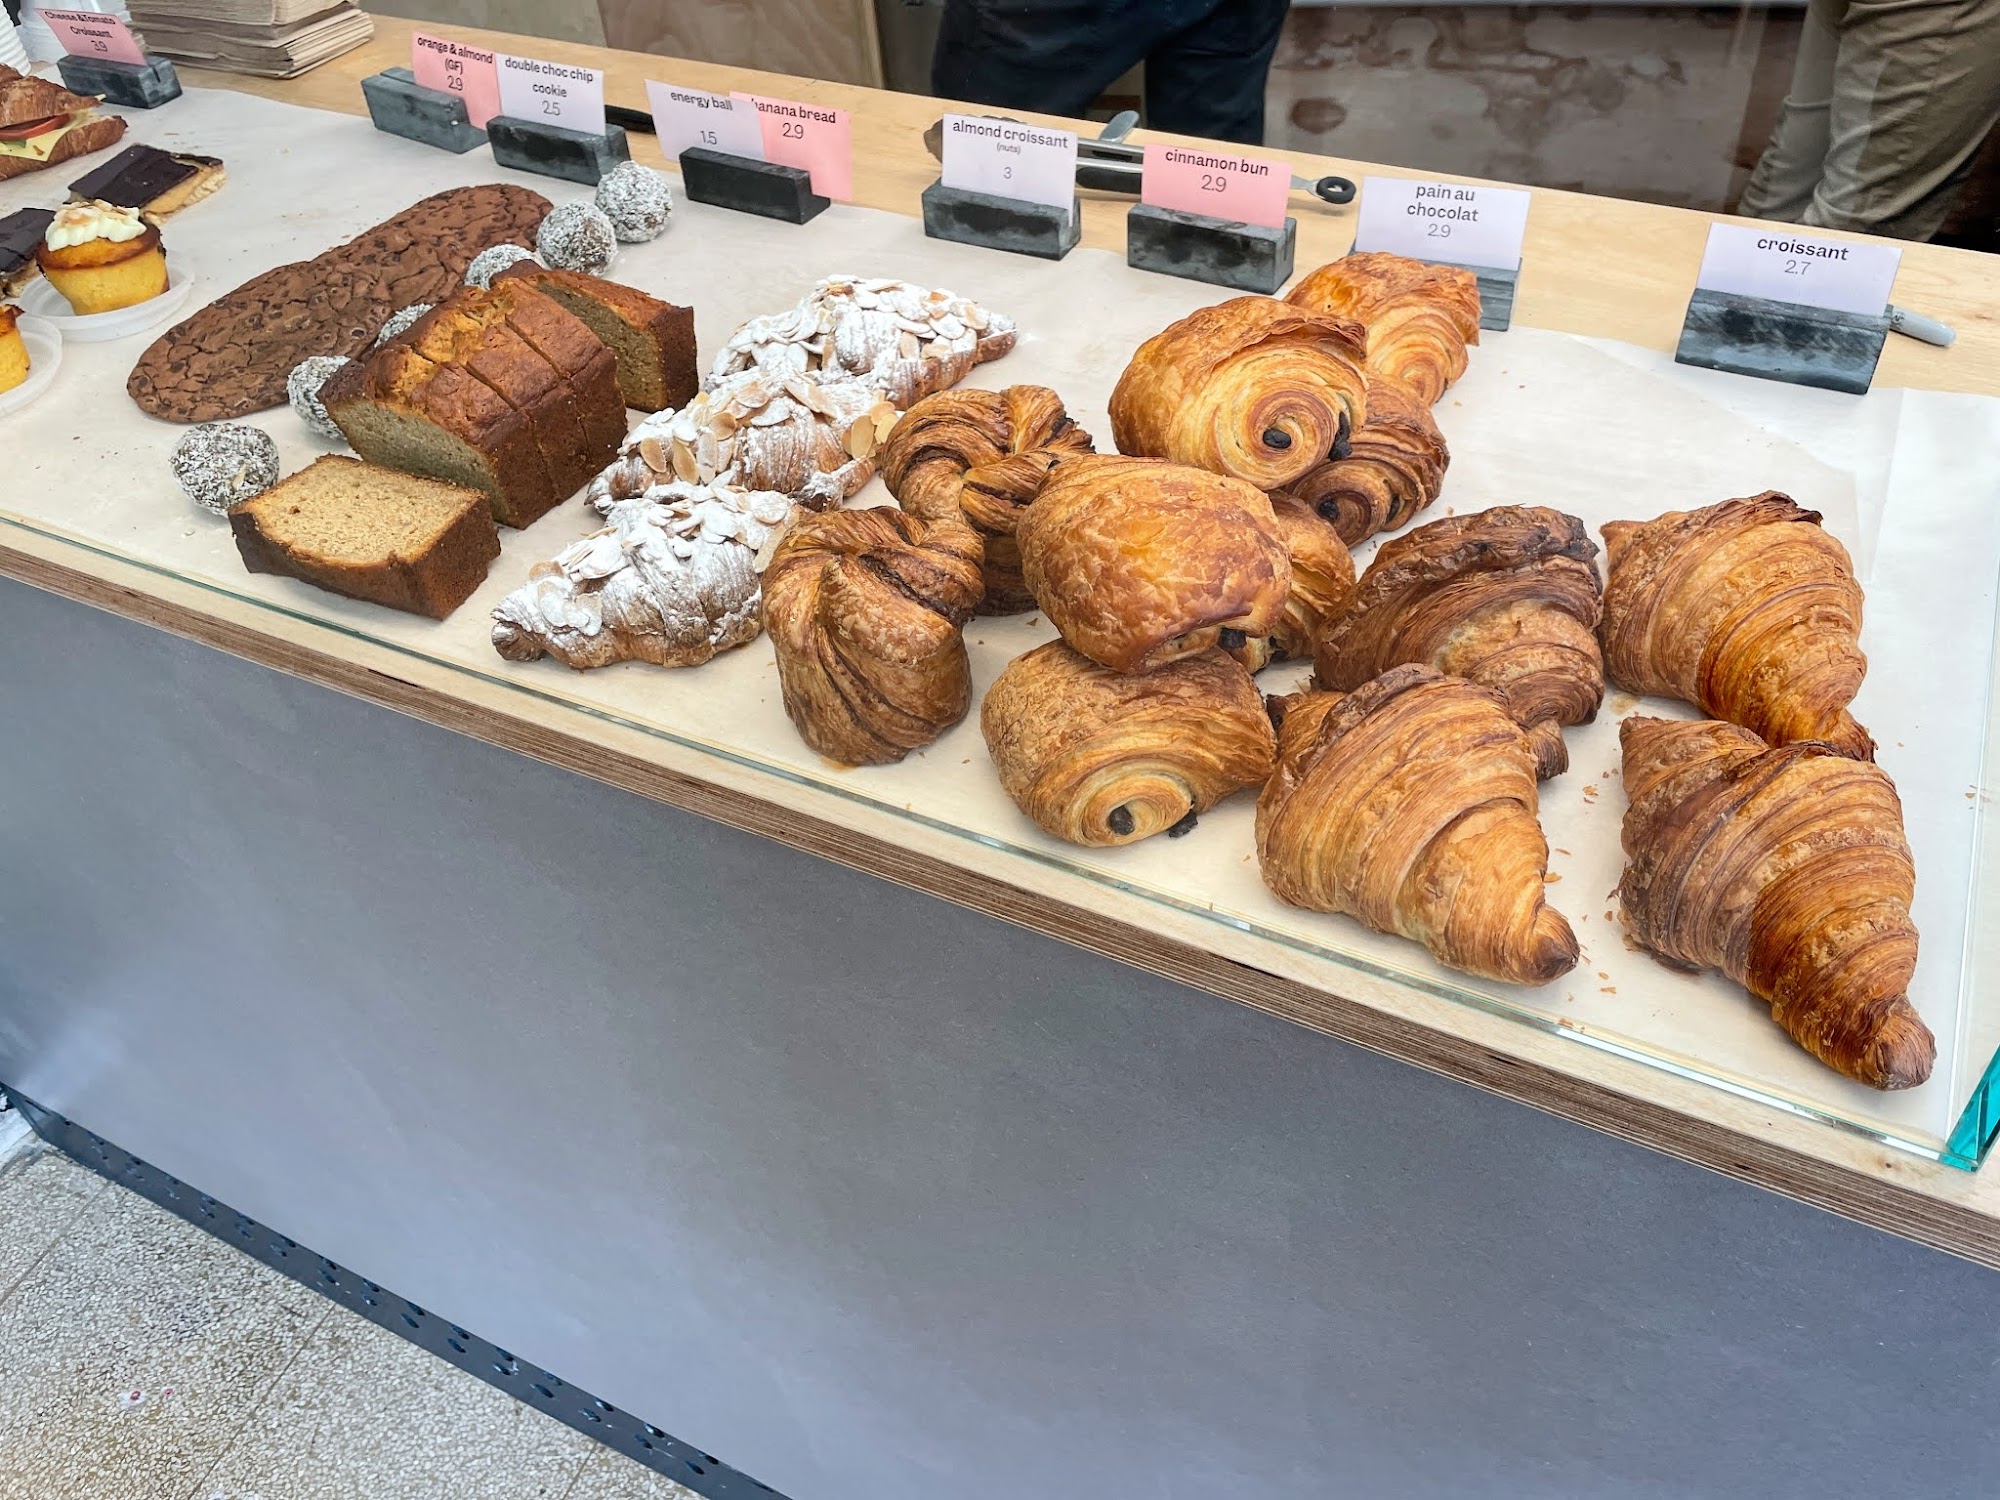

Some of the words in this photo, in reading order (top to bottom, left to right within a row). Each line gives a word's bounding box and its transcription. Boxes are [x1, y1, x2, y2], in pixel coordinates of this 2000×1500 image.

[417, 37, 448, 53] orange
[449, 43, 457, 55] &
[458, 47, 493, 64] almond
[444, 59, 464, 75] (GF)
[505, 57, 540, 73] double
[542, 63, 568, 78] choc
[570, 71, 593, 83] chip
[532, 82, 567, 98] cookie
[670, 91, 710, 109] energy
[713, 97, 733, 111] ball
[751, 98, 797, 117] anana
[799, 106, 836, 124] bread
[782, 122, 804, 140] 2.9
[953, 120, 1001, 138] almond
[1004, 130, 1068, 149] croissant
[996, 142, 1021, 155] (nuts)
[1165, 149, 1238, 172] cinnamon
[1240, 158, 1269, 176] bun
[1003, 166, 1013, 180] 3
[1201, 174, 1227, 193] 2.9
[1416, 184, 1451, 199] pain
[1454, 189, 1475, 201] au
[1407, 202, 1479, 222] chocolat
[1756, 237, 1850, 261] croissant
[1784, 259, 1812, 276] 2.7
